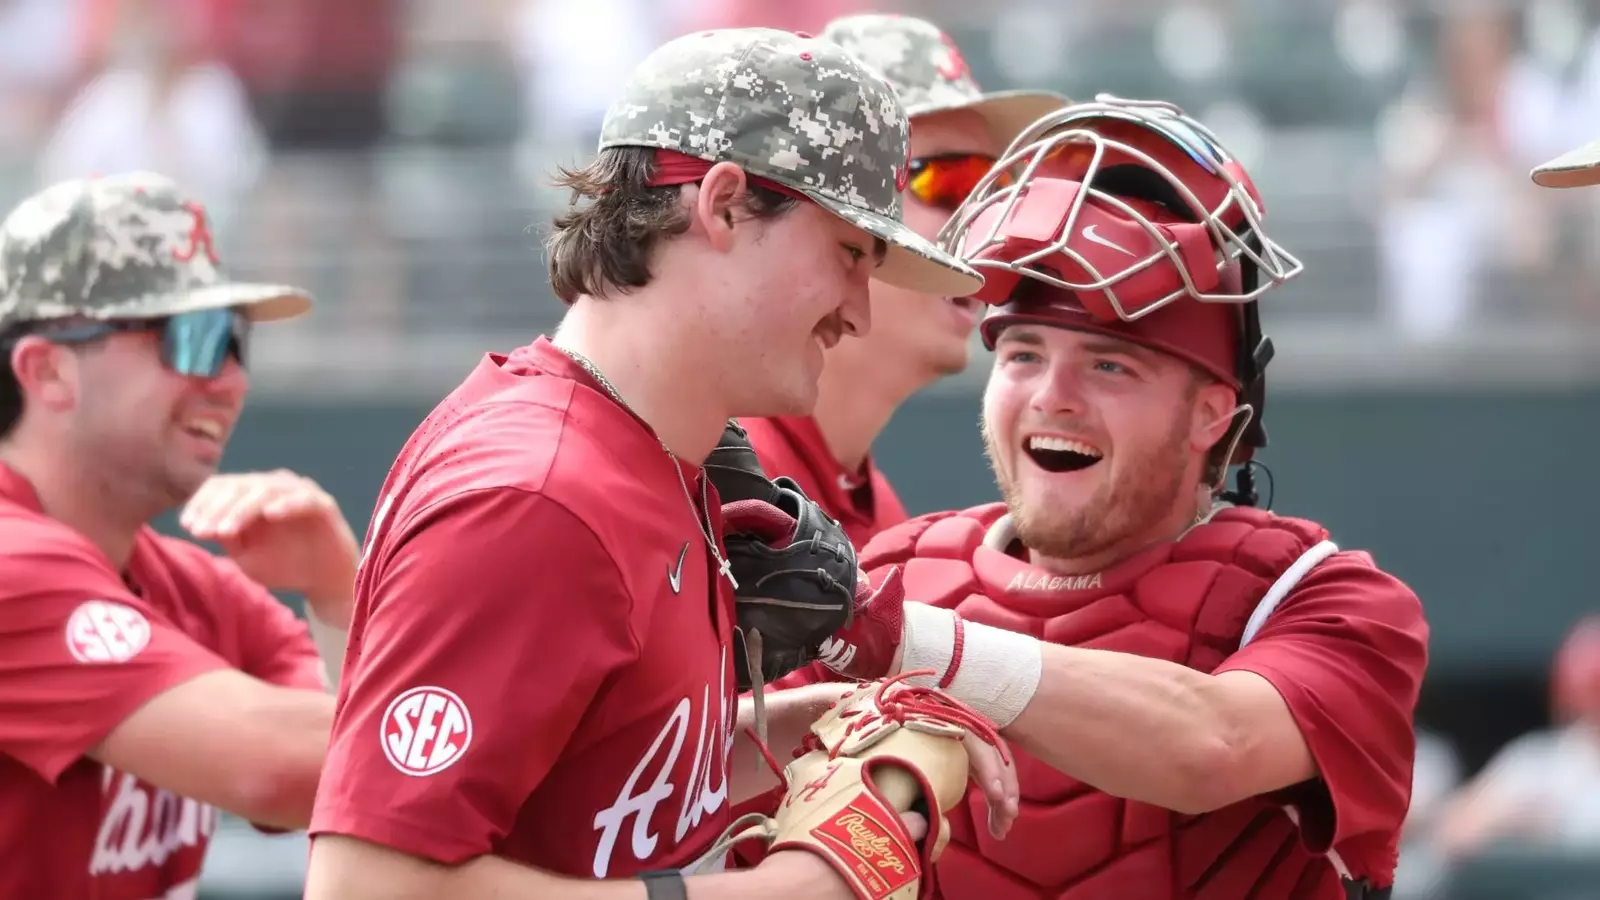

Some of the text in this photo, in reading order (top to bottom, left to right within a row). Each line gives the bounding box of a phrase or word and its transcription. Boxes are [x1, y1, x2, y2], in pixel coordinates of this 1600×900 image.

[1004, 572, 1103, 592] ALABAMA
[71, 603, 148, 661] SEC
[387, 692, 466, 770] SEC
[835, 812, 905, 875] Rawlings
